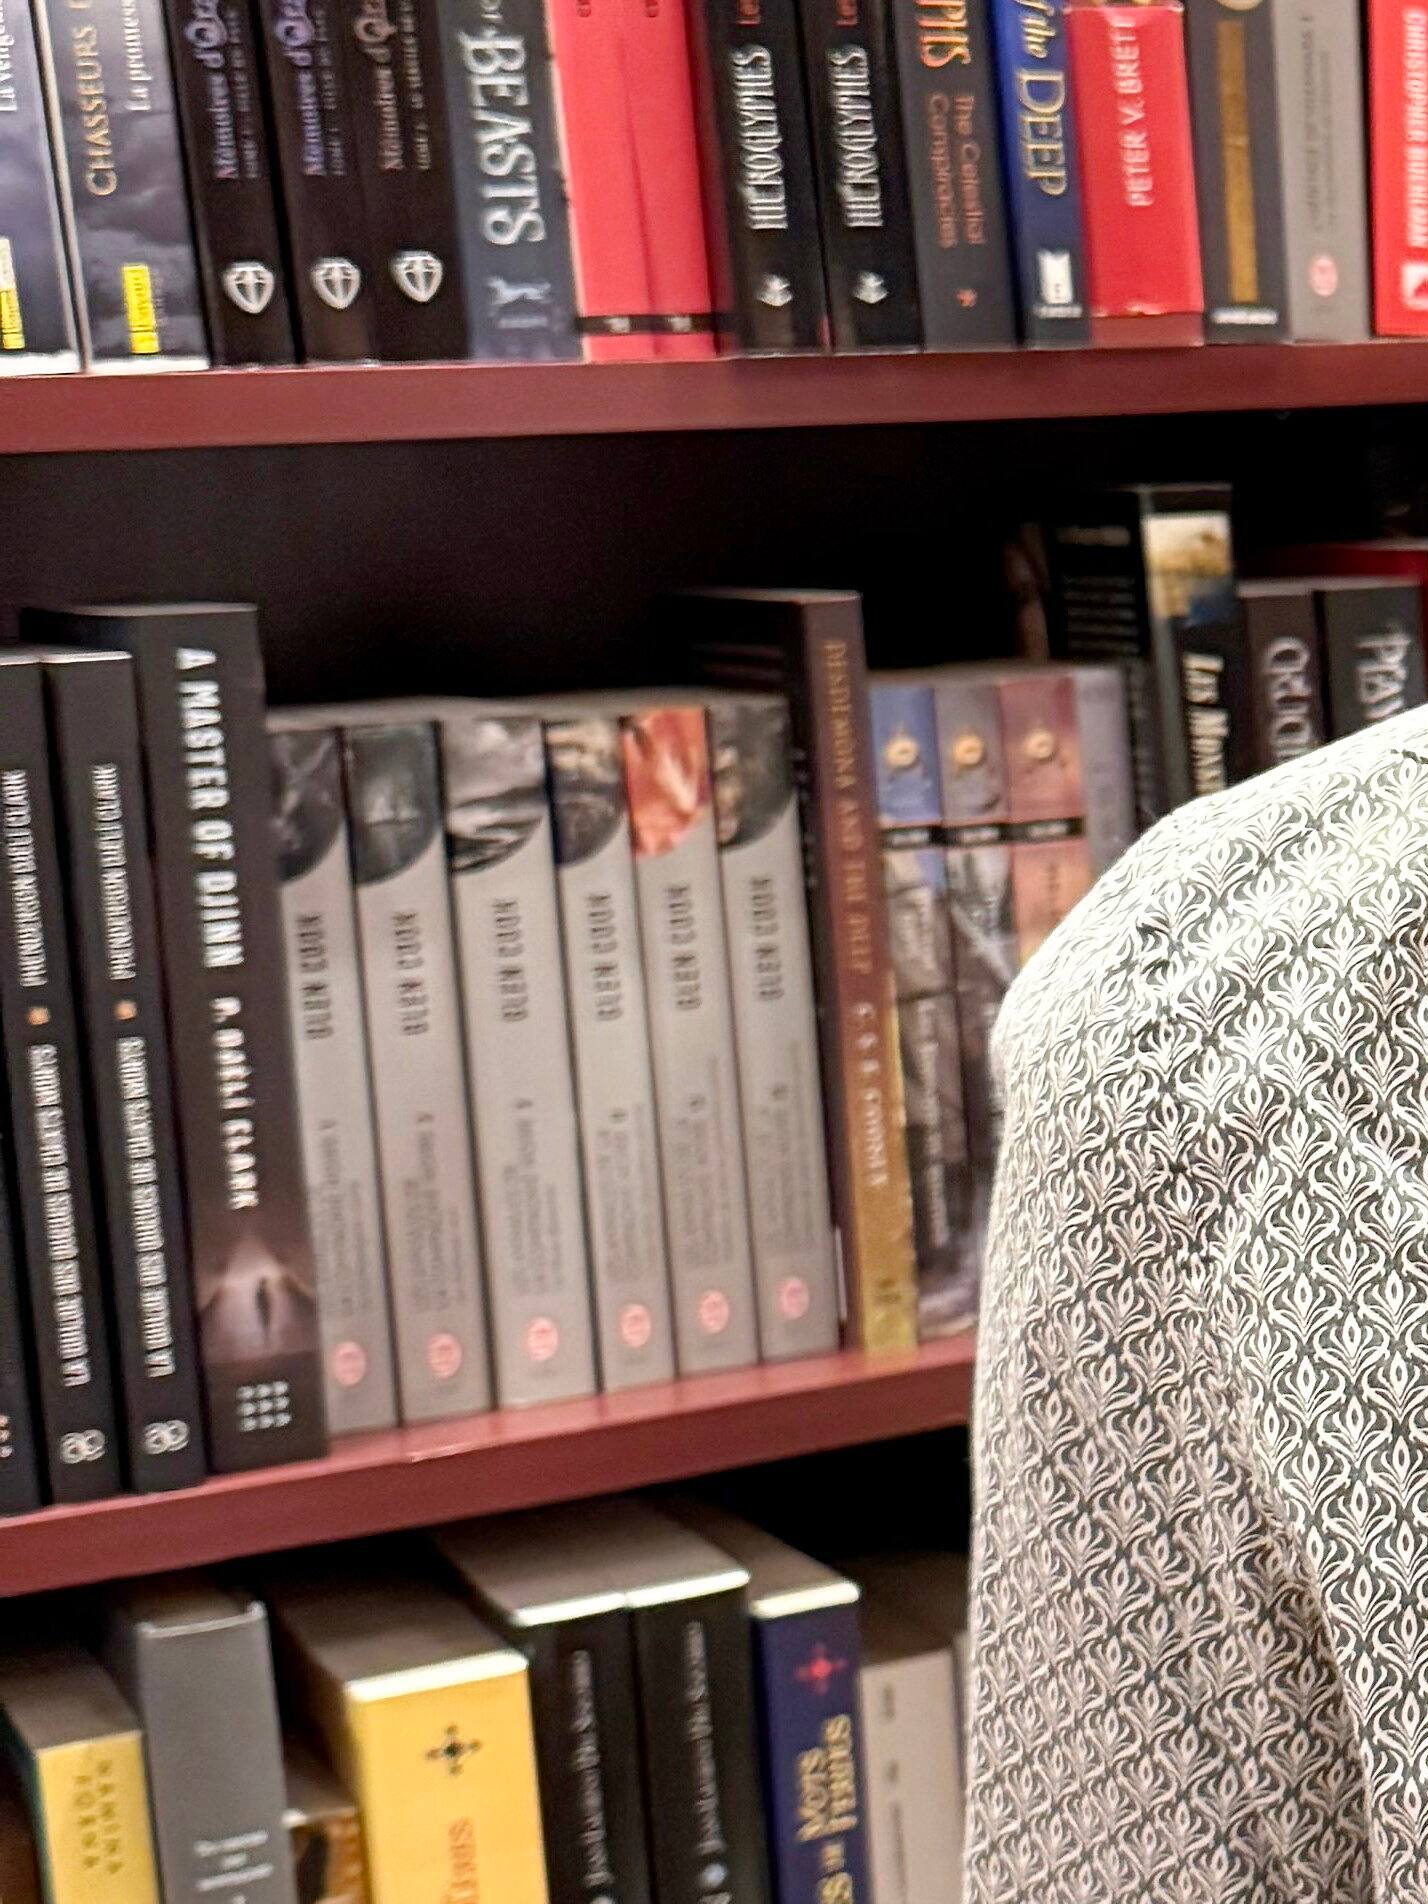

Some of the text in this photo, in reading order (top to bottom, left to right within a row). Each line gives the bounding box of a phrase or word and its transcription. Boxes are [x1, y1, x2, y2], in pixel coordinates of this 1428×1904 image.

[66, 18, 119, 200] CHASSEURS
[458, 29, 548, 248] BEASTS
[1015, 68, 1067, 197] DEEP
[1107, 15, 1154, 207] PETER BRETT
[1400, 8, 1428, 150] CHRISTOPHER
[175, 647, 245, 970] A MASTER OF DJINN
